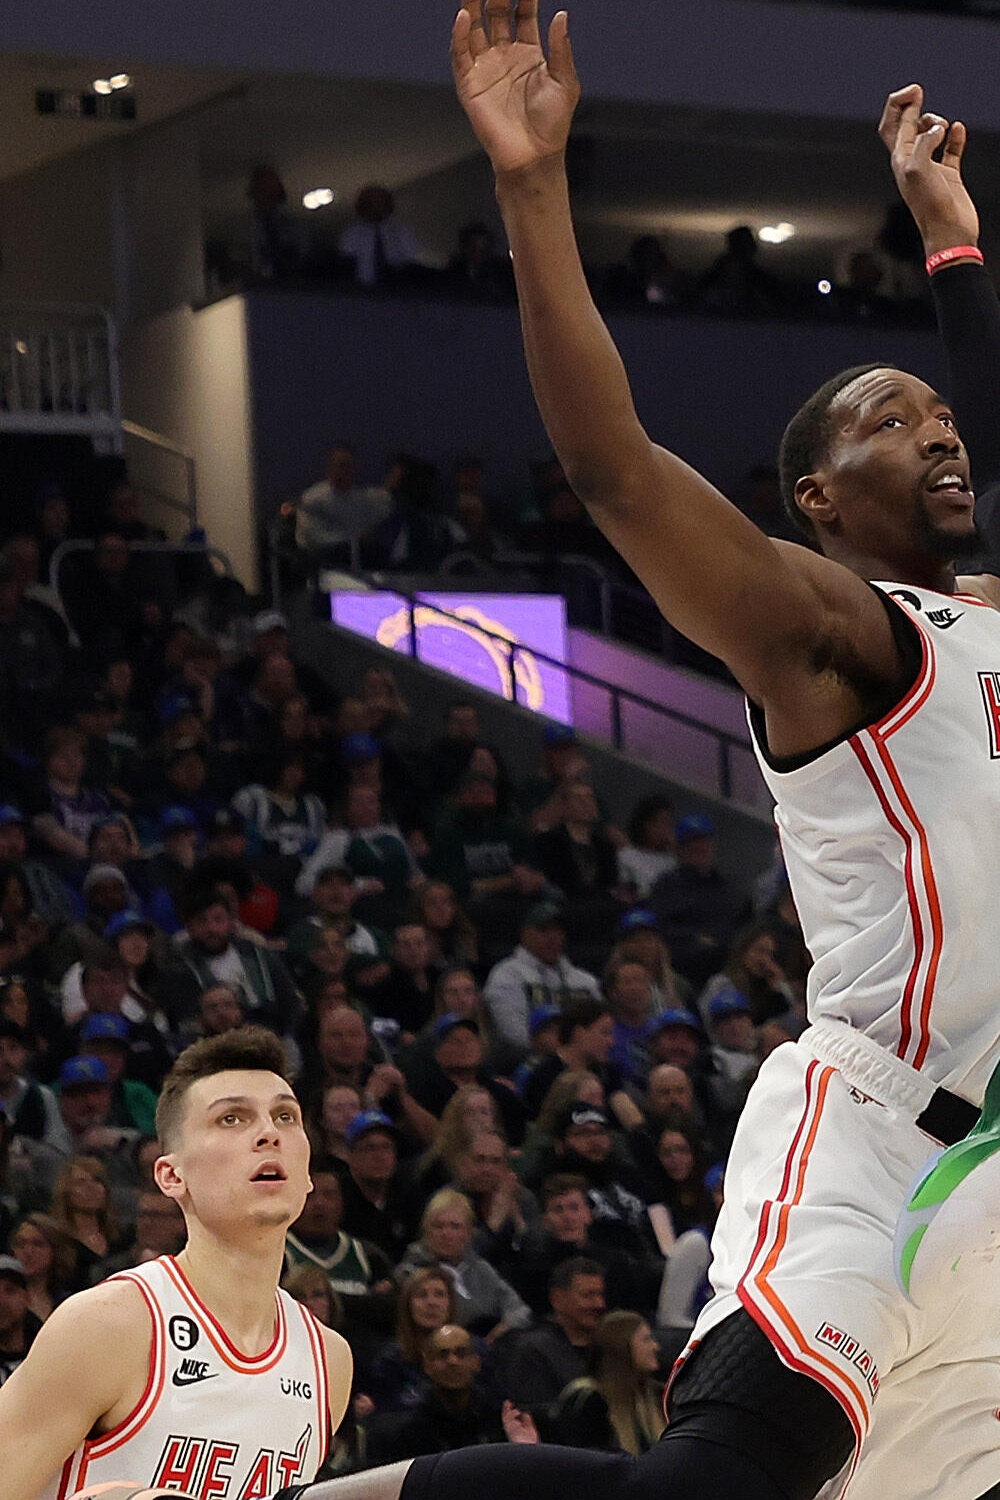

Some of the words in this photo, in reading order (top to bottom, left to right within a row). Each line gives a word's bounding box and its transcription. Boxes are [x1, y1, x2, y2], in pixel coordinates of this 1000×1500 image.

[173, 1320, 192, 1348] 6
[179, 1358, 210, 1378] NIKE
[149, 1422, 313, 1500] HEAT
